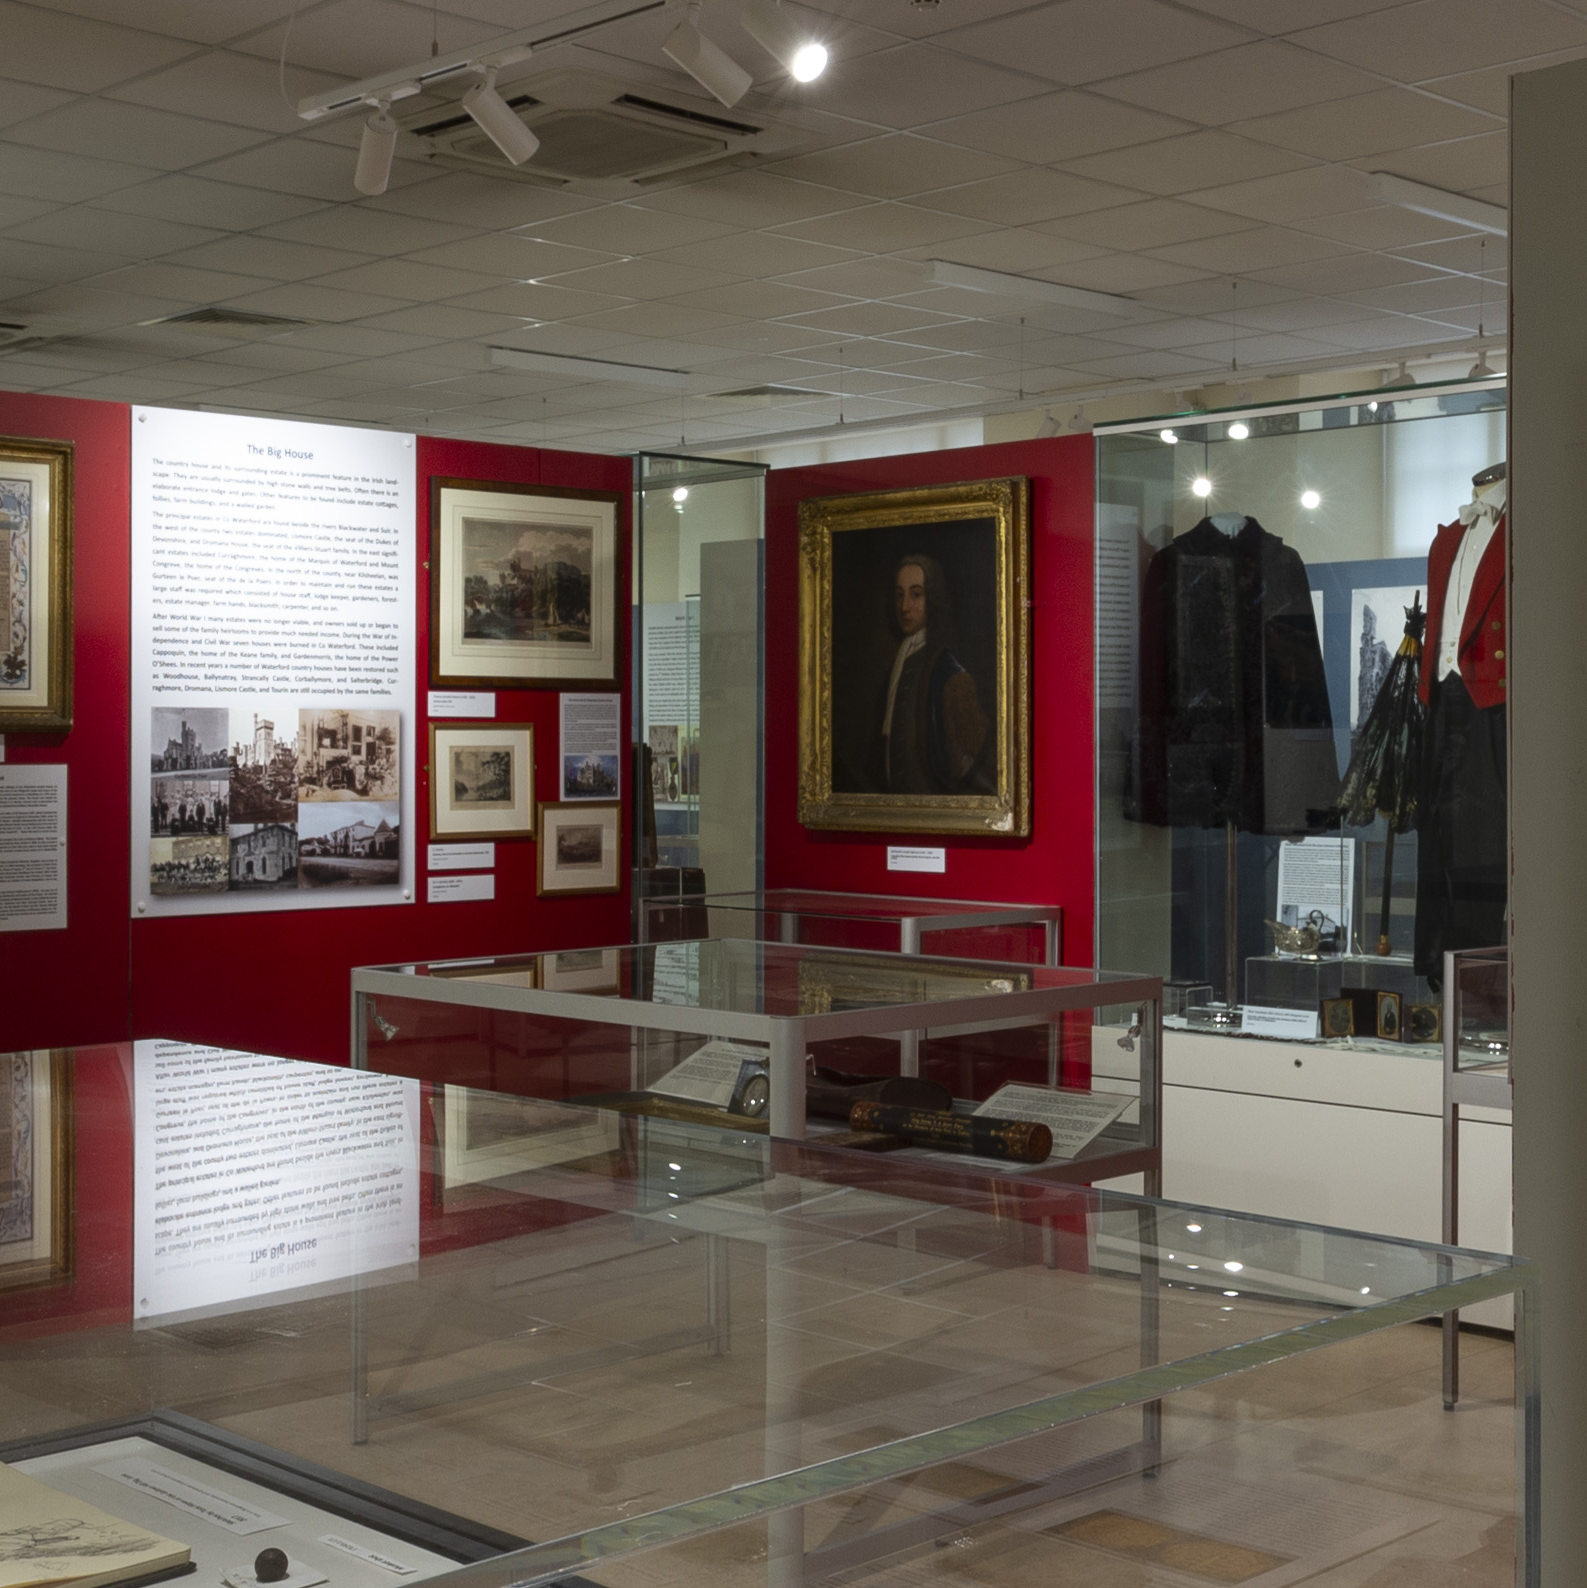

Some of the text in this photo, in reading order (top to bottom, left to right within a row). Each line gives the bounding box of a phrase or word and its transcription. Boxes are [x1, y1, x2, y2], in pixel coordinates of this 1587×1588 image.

[246, 444, 313, 460] The Big House
[184, 684, 213, 692] Dromana,
[238, 685, 257, 693] Castle,
[336, 687, 343, 695] by
